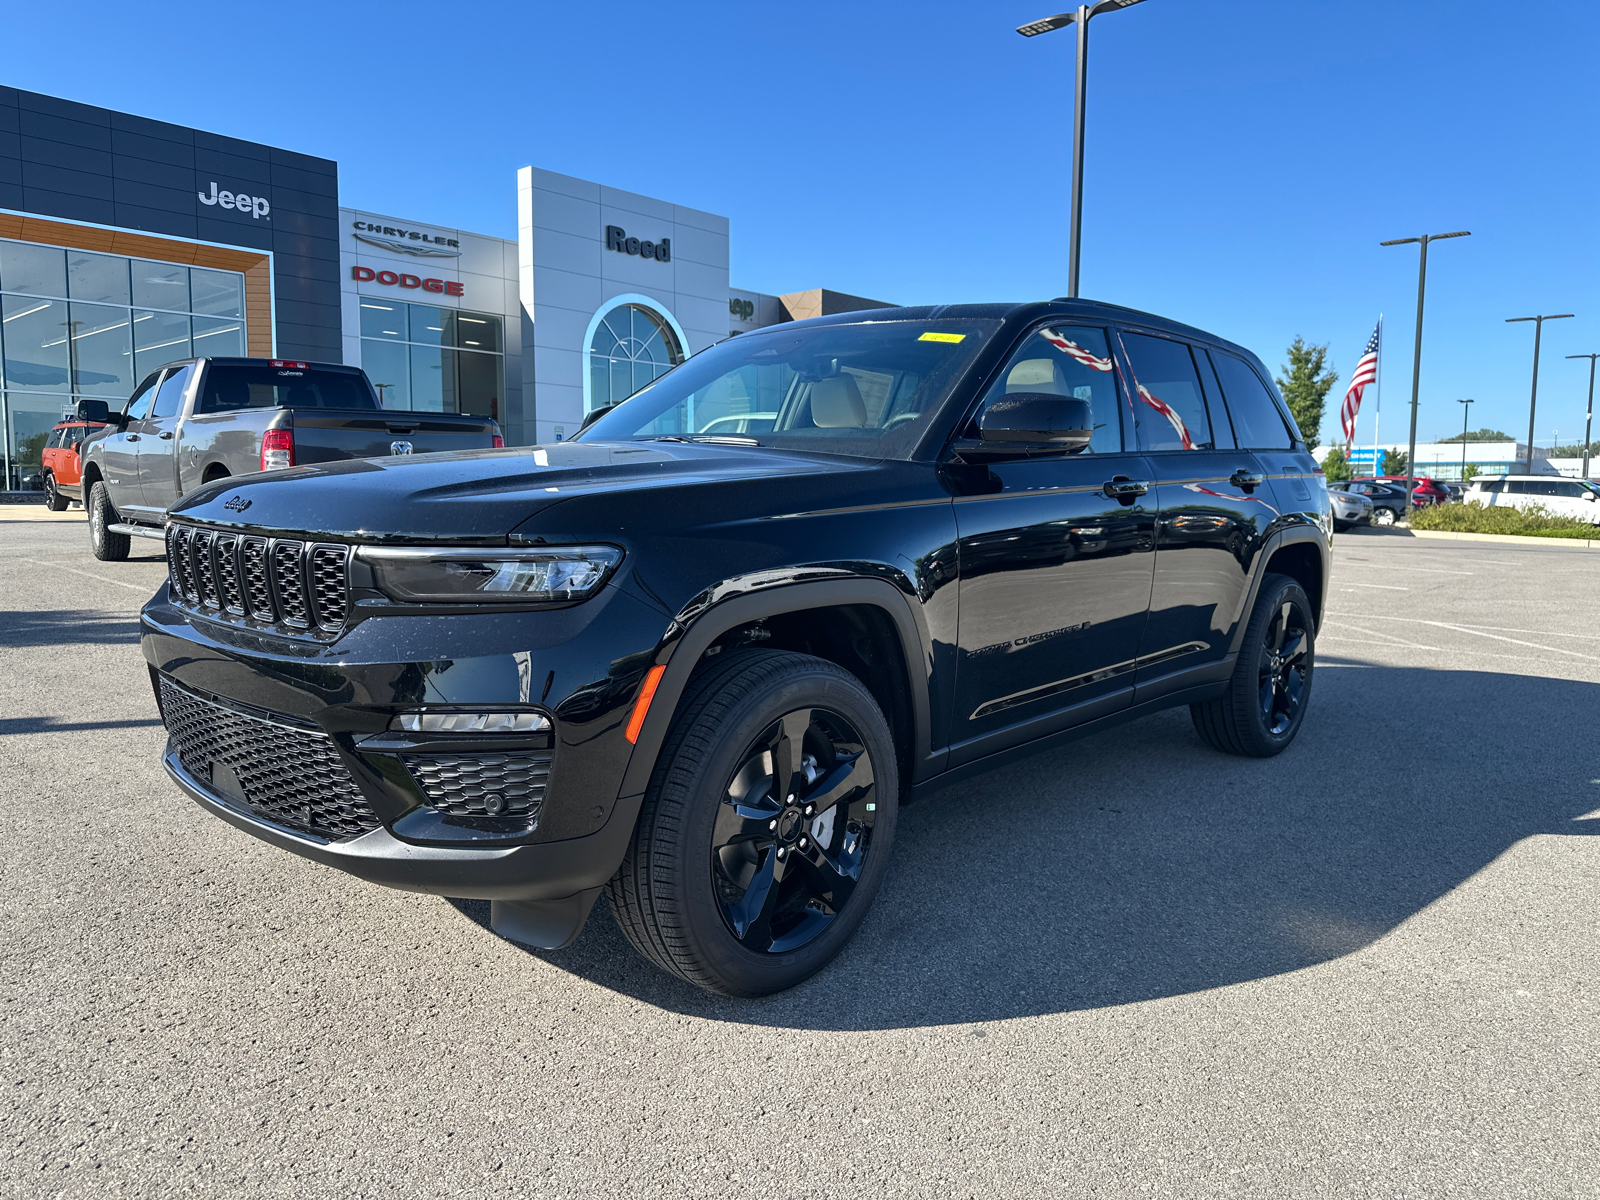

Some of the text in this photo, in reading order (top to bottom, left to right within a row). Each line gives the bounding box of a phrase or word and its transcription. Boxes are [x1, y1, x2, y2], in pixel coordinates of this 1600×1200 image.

[198, 182, 270, 219] Jeep
[353, 221, 460, 249] CHRYSLER
[606, 225, 671, 262] Reed
[352, 265, 464, 296] DODGE
